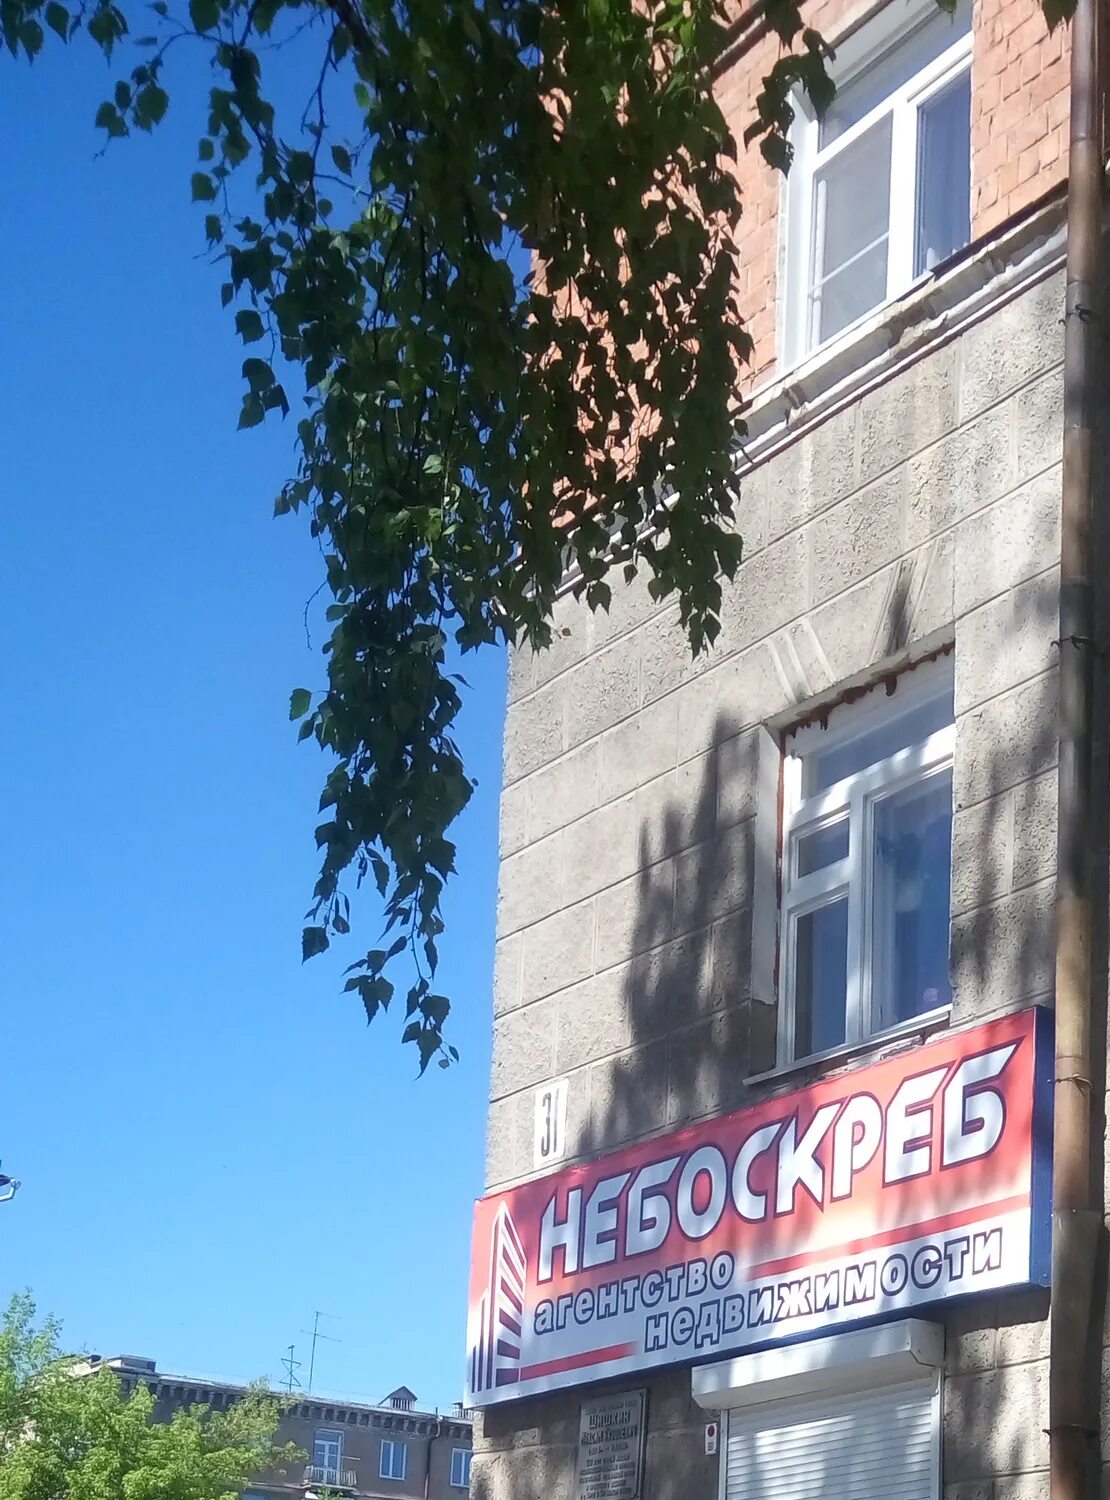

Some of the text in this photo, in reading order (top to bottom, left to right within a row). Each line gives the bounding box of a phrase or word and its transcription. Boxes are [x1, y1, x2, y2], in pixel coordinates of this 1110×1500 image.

[537, 1036, 1026, 1286] НЕБОСКРЕБ
[541, 1087, 560, 1157] 31
[534, 1250, 735, 1336] агентство
[645, 1226, 1003, 1354] недвижимости
